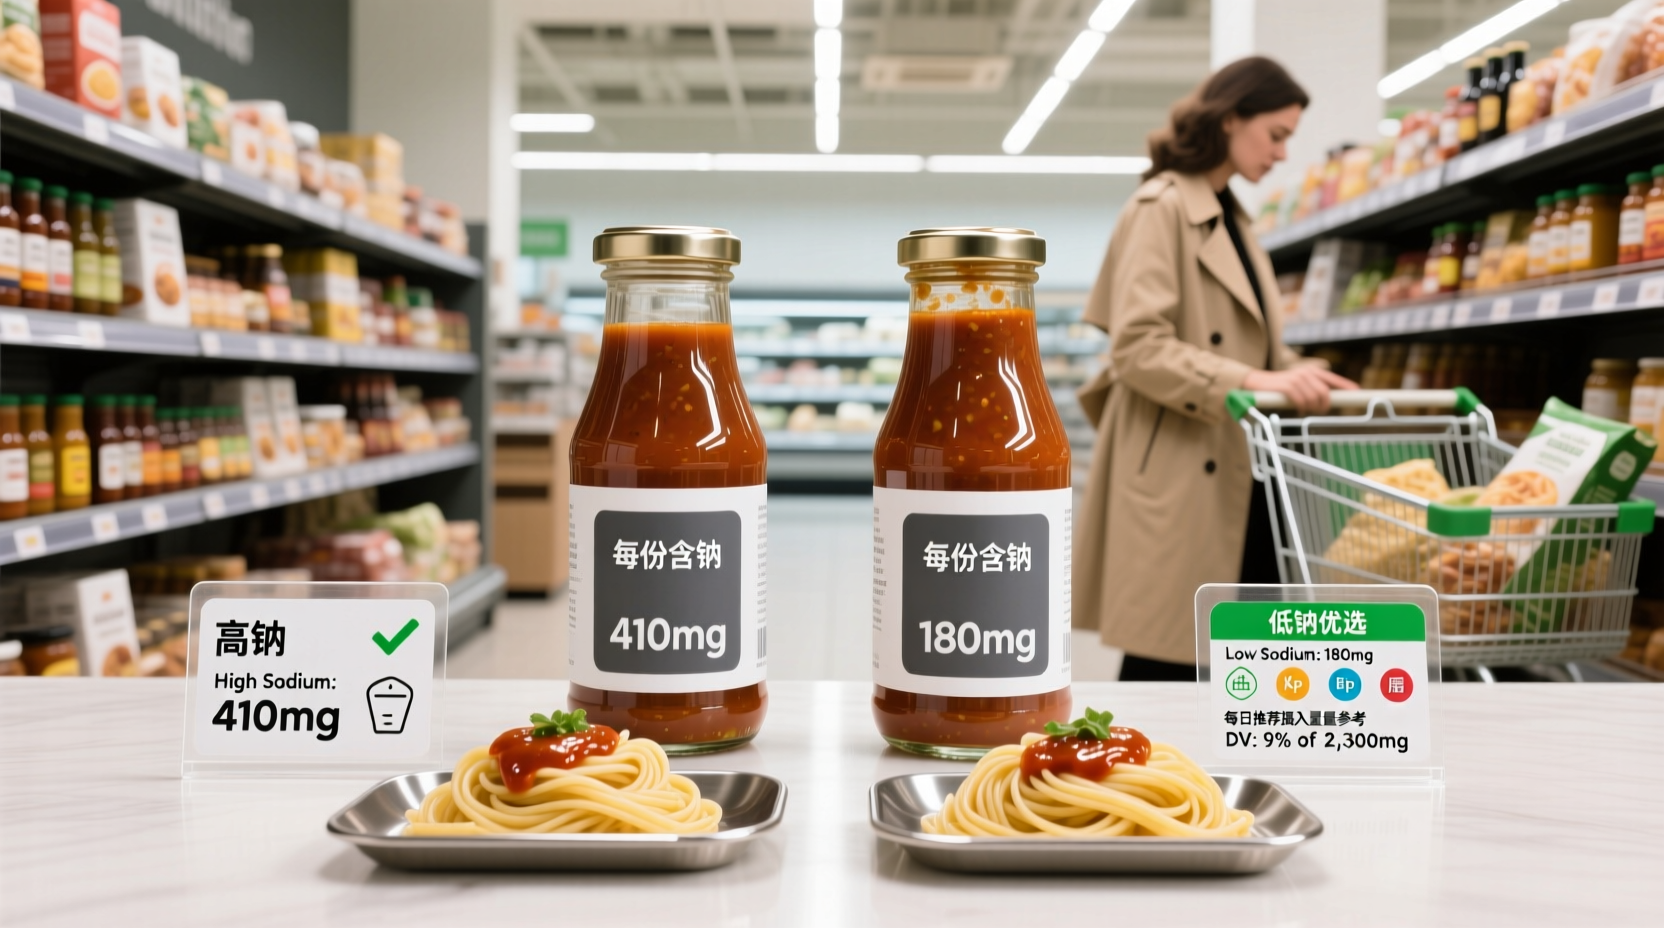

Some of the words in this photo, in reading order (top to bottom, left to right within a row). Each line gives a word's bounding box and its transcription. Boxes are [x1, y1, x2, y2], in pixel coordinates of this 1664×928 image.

[612, 538, 722, 570] 每份含钠
[922, 540, 1032, 573] 每份含钠
[215, 619, 286, 657] 高钠
[609, 617, 726, 659] 410mg
[918, 620, 1036, 663] 180mg
[1225, 646, 1257, 661] Low
[1260, 646, 1321, 662] Sodium:
[1324, 647, 1374, 665] 180mg
[214, 672, 257, 694] High
[262, 672, 337, 690] Sodium:
[211, 699, 340, 742] 410mg
[1226, 731, 1257, 748] DV:
[1263, 731, 1292, 748] 9%
[1297, 731, 1318, 748] of
[1324, 731, 1409, 754] 2,300mg
